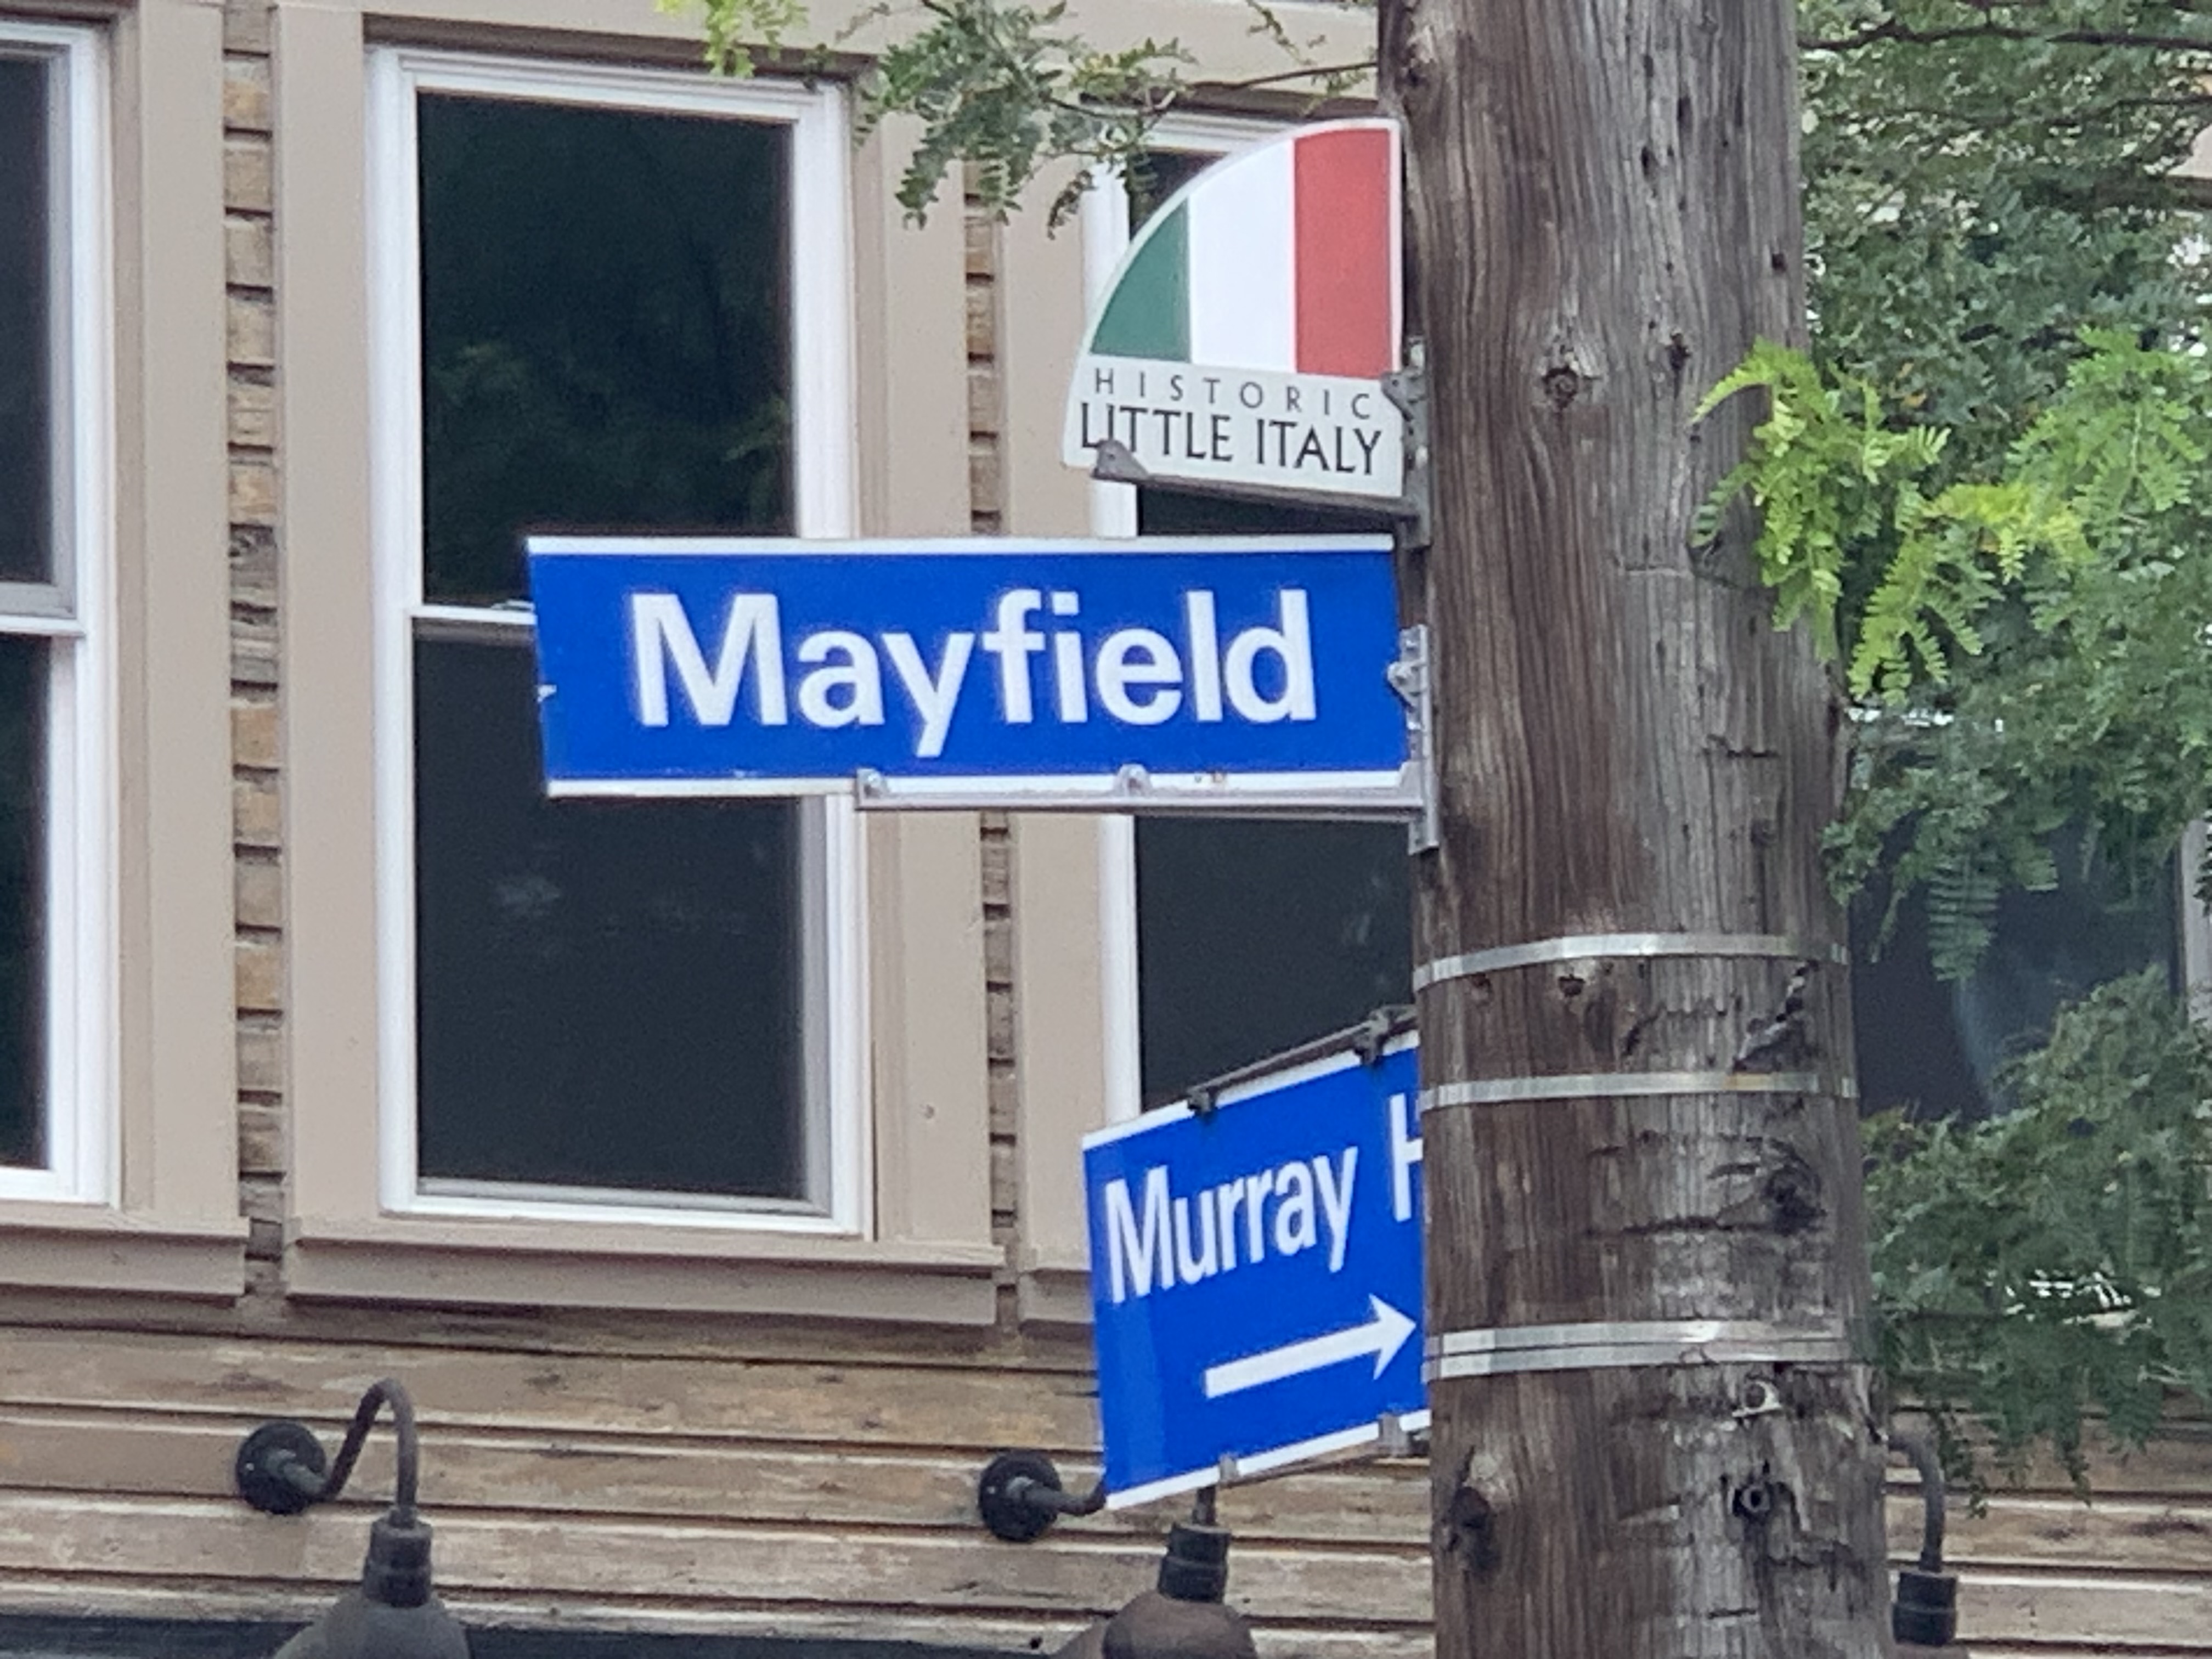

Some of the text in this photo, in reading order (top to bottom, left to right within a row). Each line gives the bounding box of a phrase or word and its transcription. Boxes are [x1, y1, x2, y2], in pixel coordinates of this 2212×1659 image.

[1080, 402, 1382, 476] LITTLE ITALY
[1094, 368, 1372, 421] HISTORIC
[630, 588, 1317, 759] Mayfield
[1104, 1146, 1359, 1304] Murray
